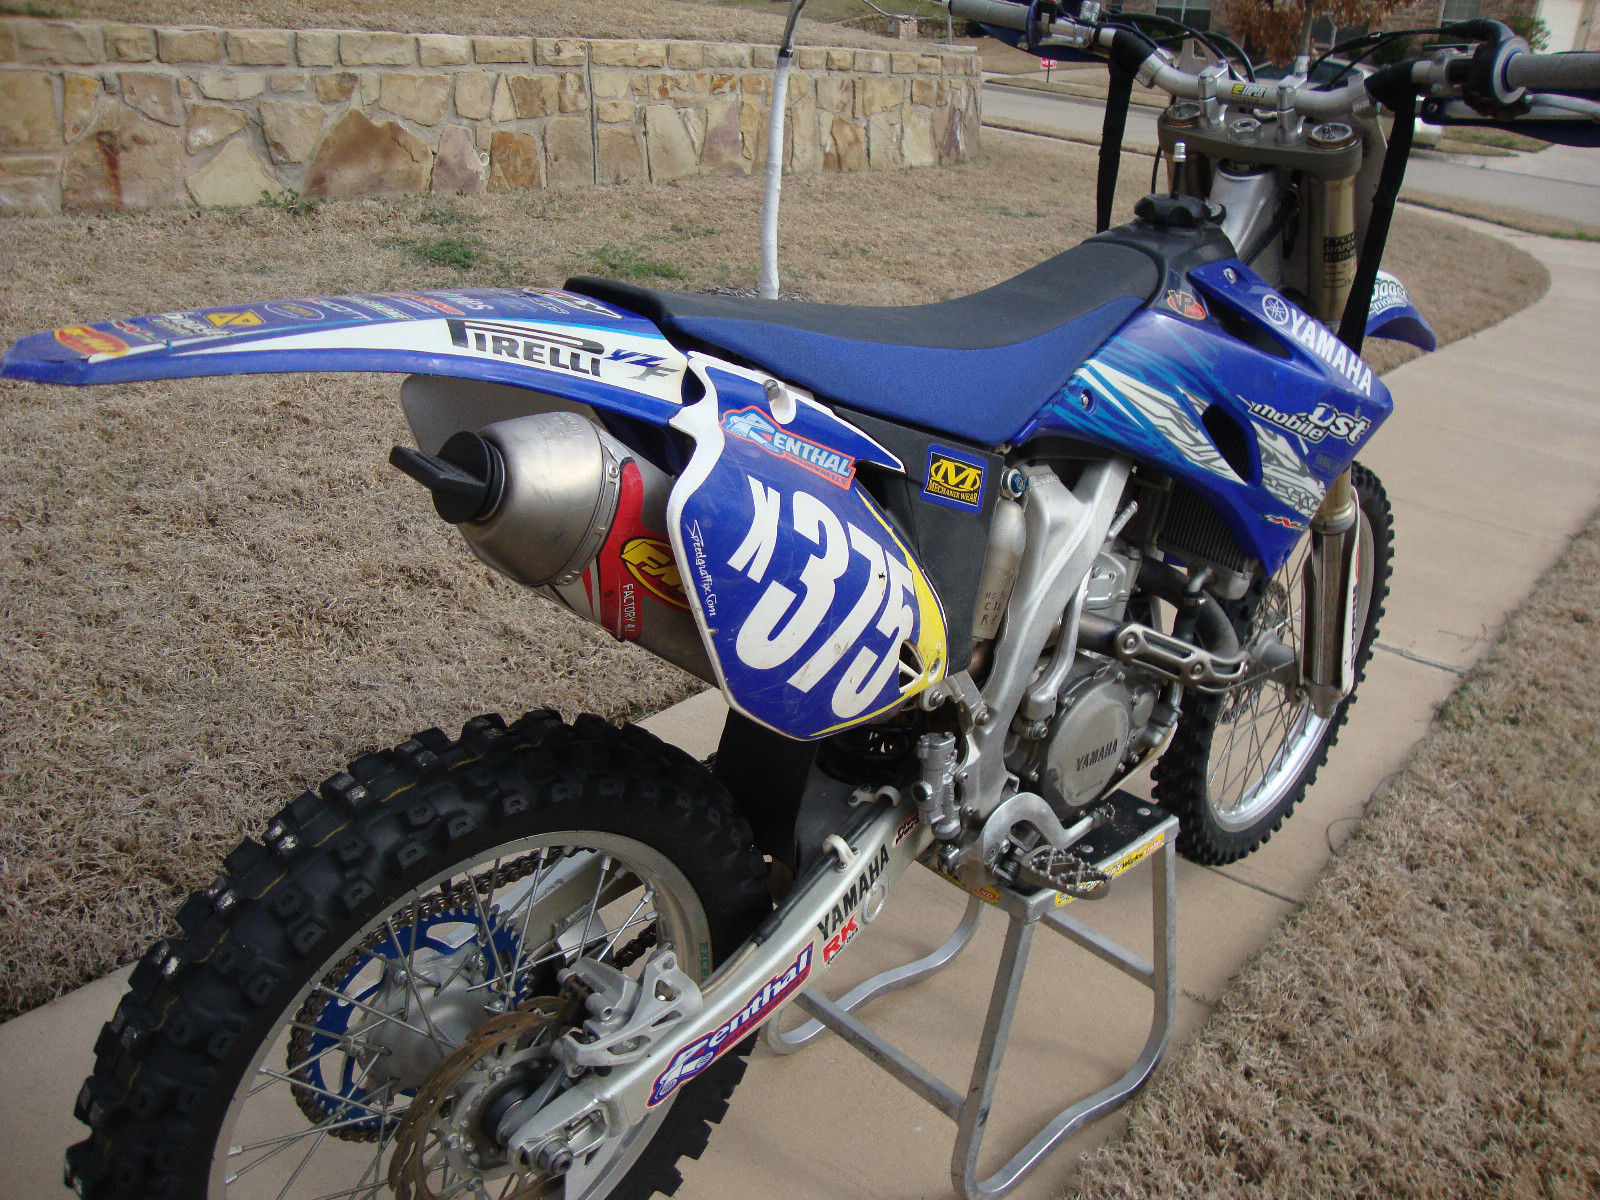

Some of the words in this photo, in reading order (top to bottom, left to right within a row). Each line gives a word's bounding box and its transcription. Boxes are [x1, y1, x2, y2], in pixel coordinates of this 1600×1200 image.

[445, 319, 605, 378] PIRELLI
[1291, 308, 1372, 397] YAMAHA
[1252, 402, 1324, 440] mobile
[927, 480, 961, 499] MECHANIX
[960, 491, 978, 503] WEAR
[623, 583, 636, 622] FACTORY
[1076, 738, 1118, 772] YAMAHA
[816, 843, 890, 941] YAMAHA
[822, 911, 858, 963] RK
